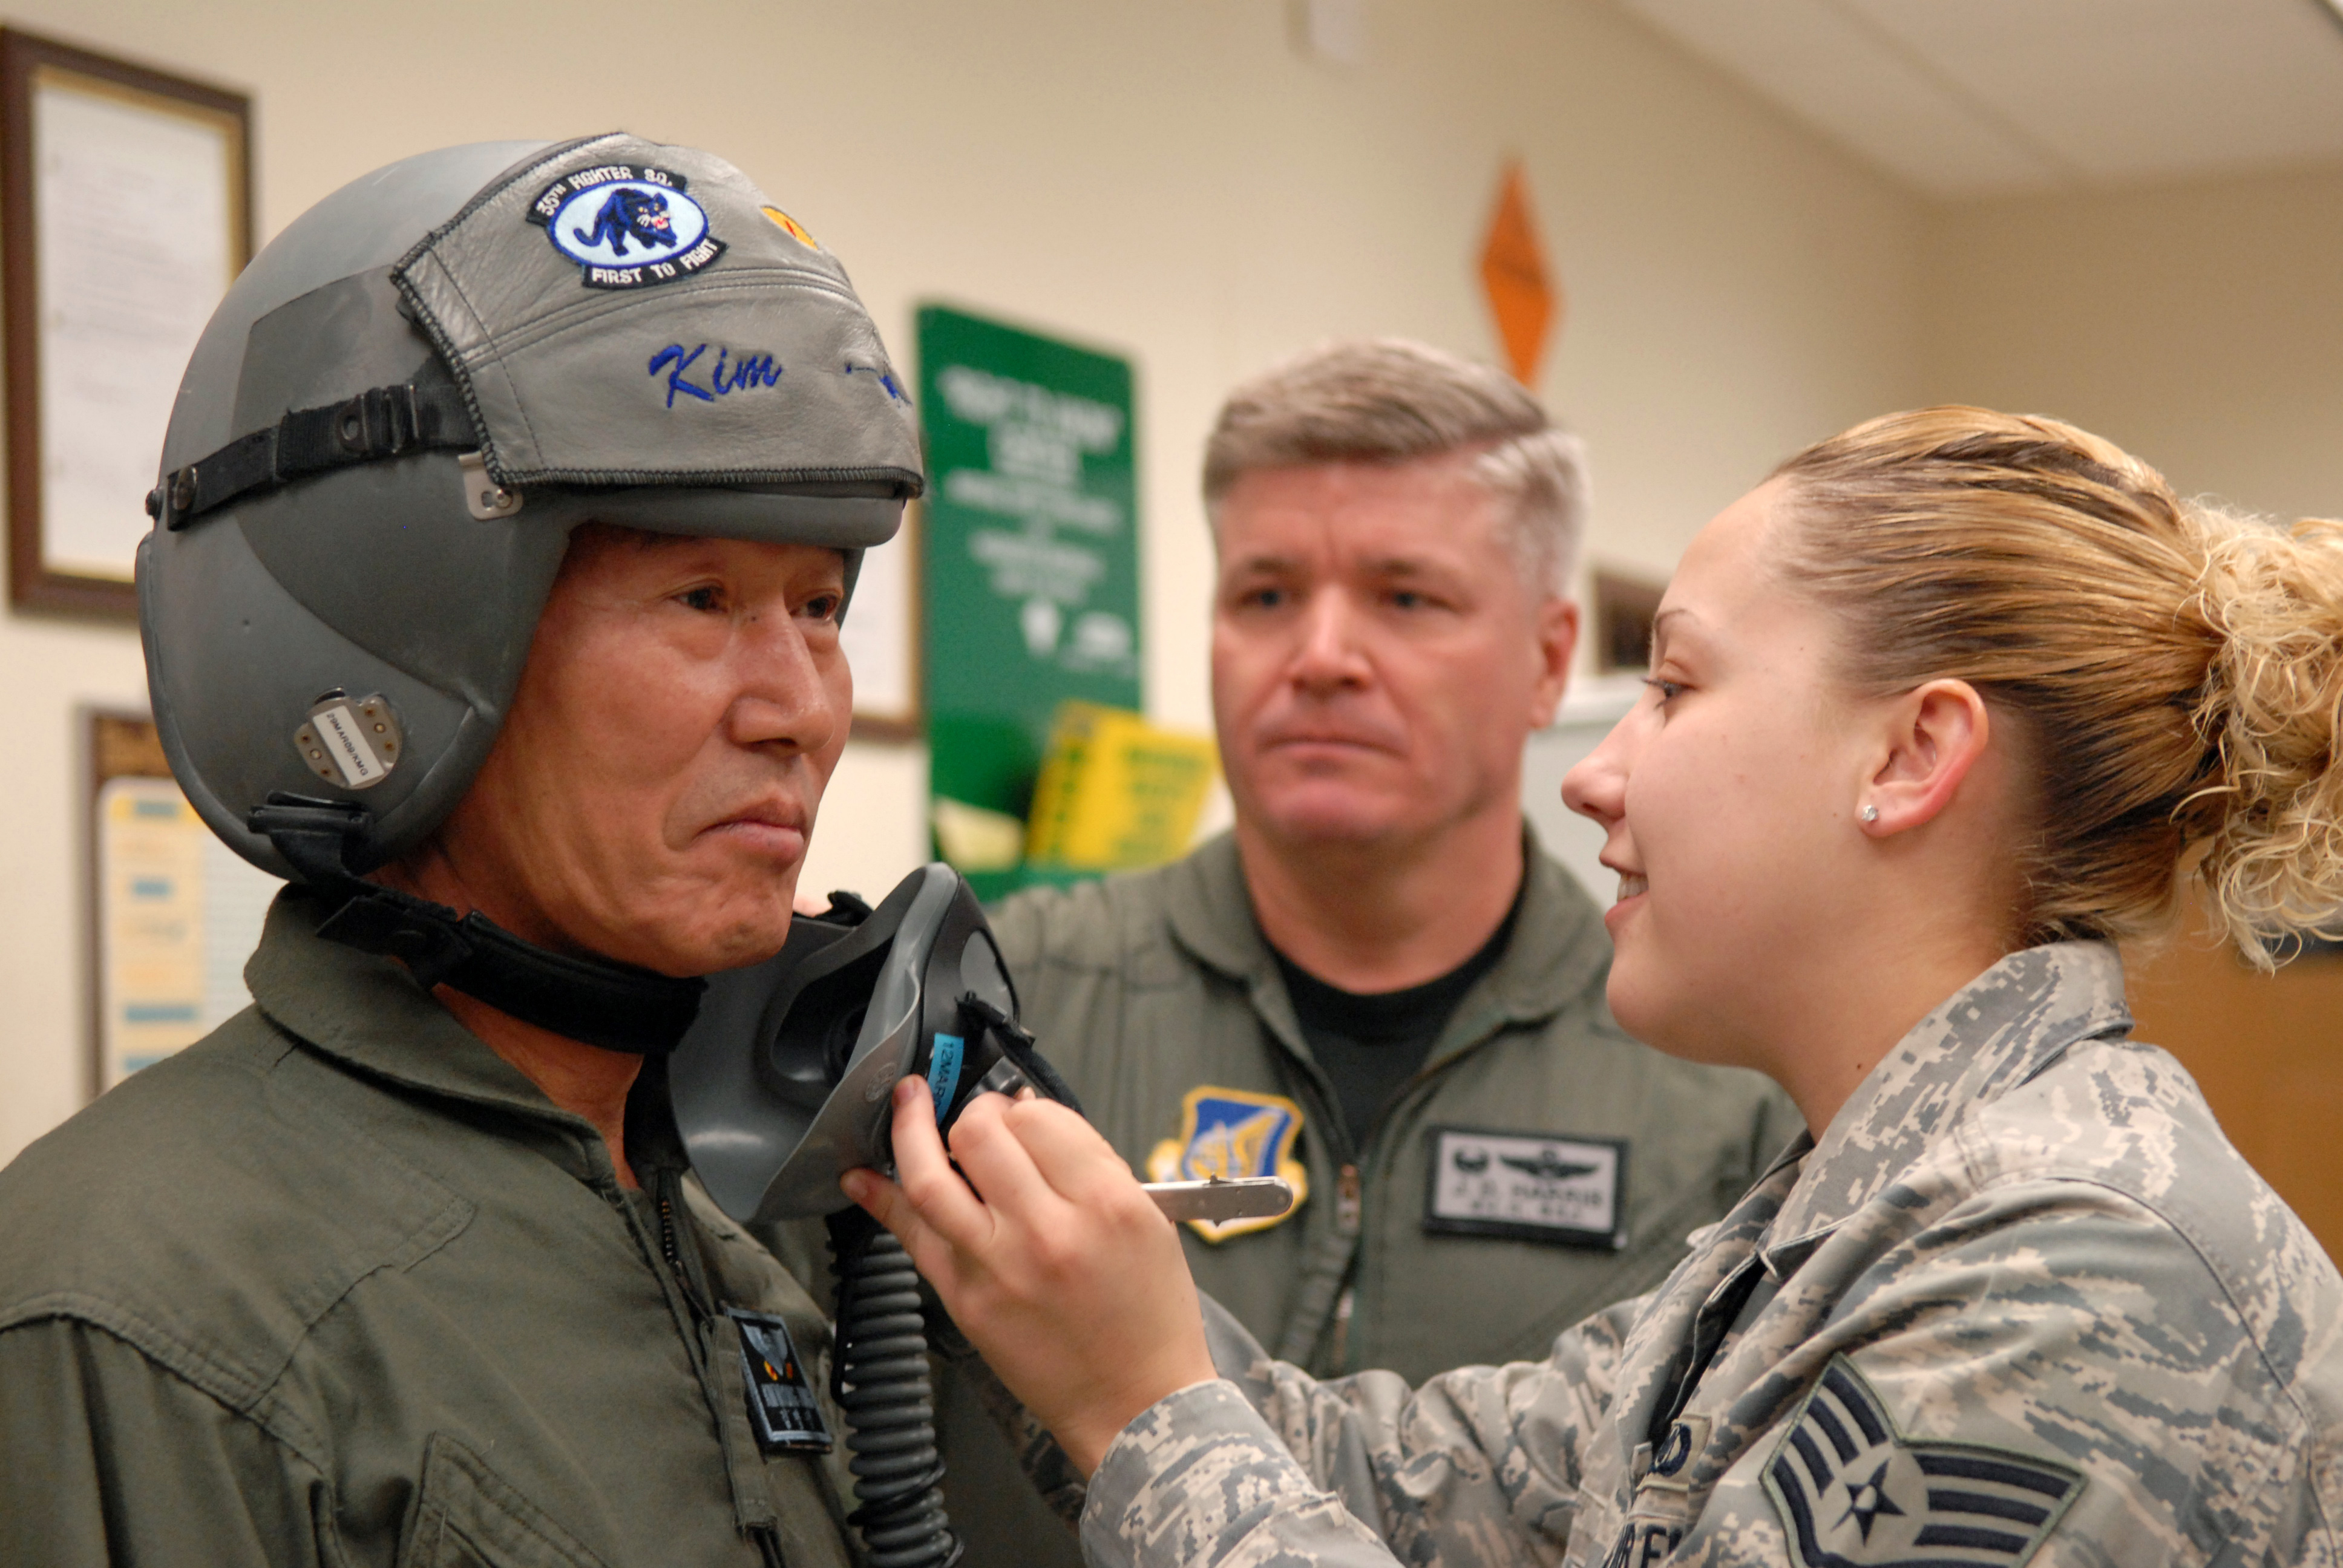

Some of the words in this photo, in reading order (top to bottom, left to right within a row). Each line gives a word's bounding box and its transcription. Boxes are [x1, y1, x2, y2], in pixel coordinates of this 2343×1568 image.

[536, 184, 566, 217] 35TH
[568, 166, 634, 190] FIGHTER
[591, 267, 643, 284] FIRST
[650, 264, 676, 279] TO
[680, 240, 718, 270] FIGHT
[648, 344, 783, 408] Kim
